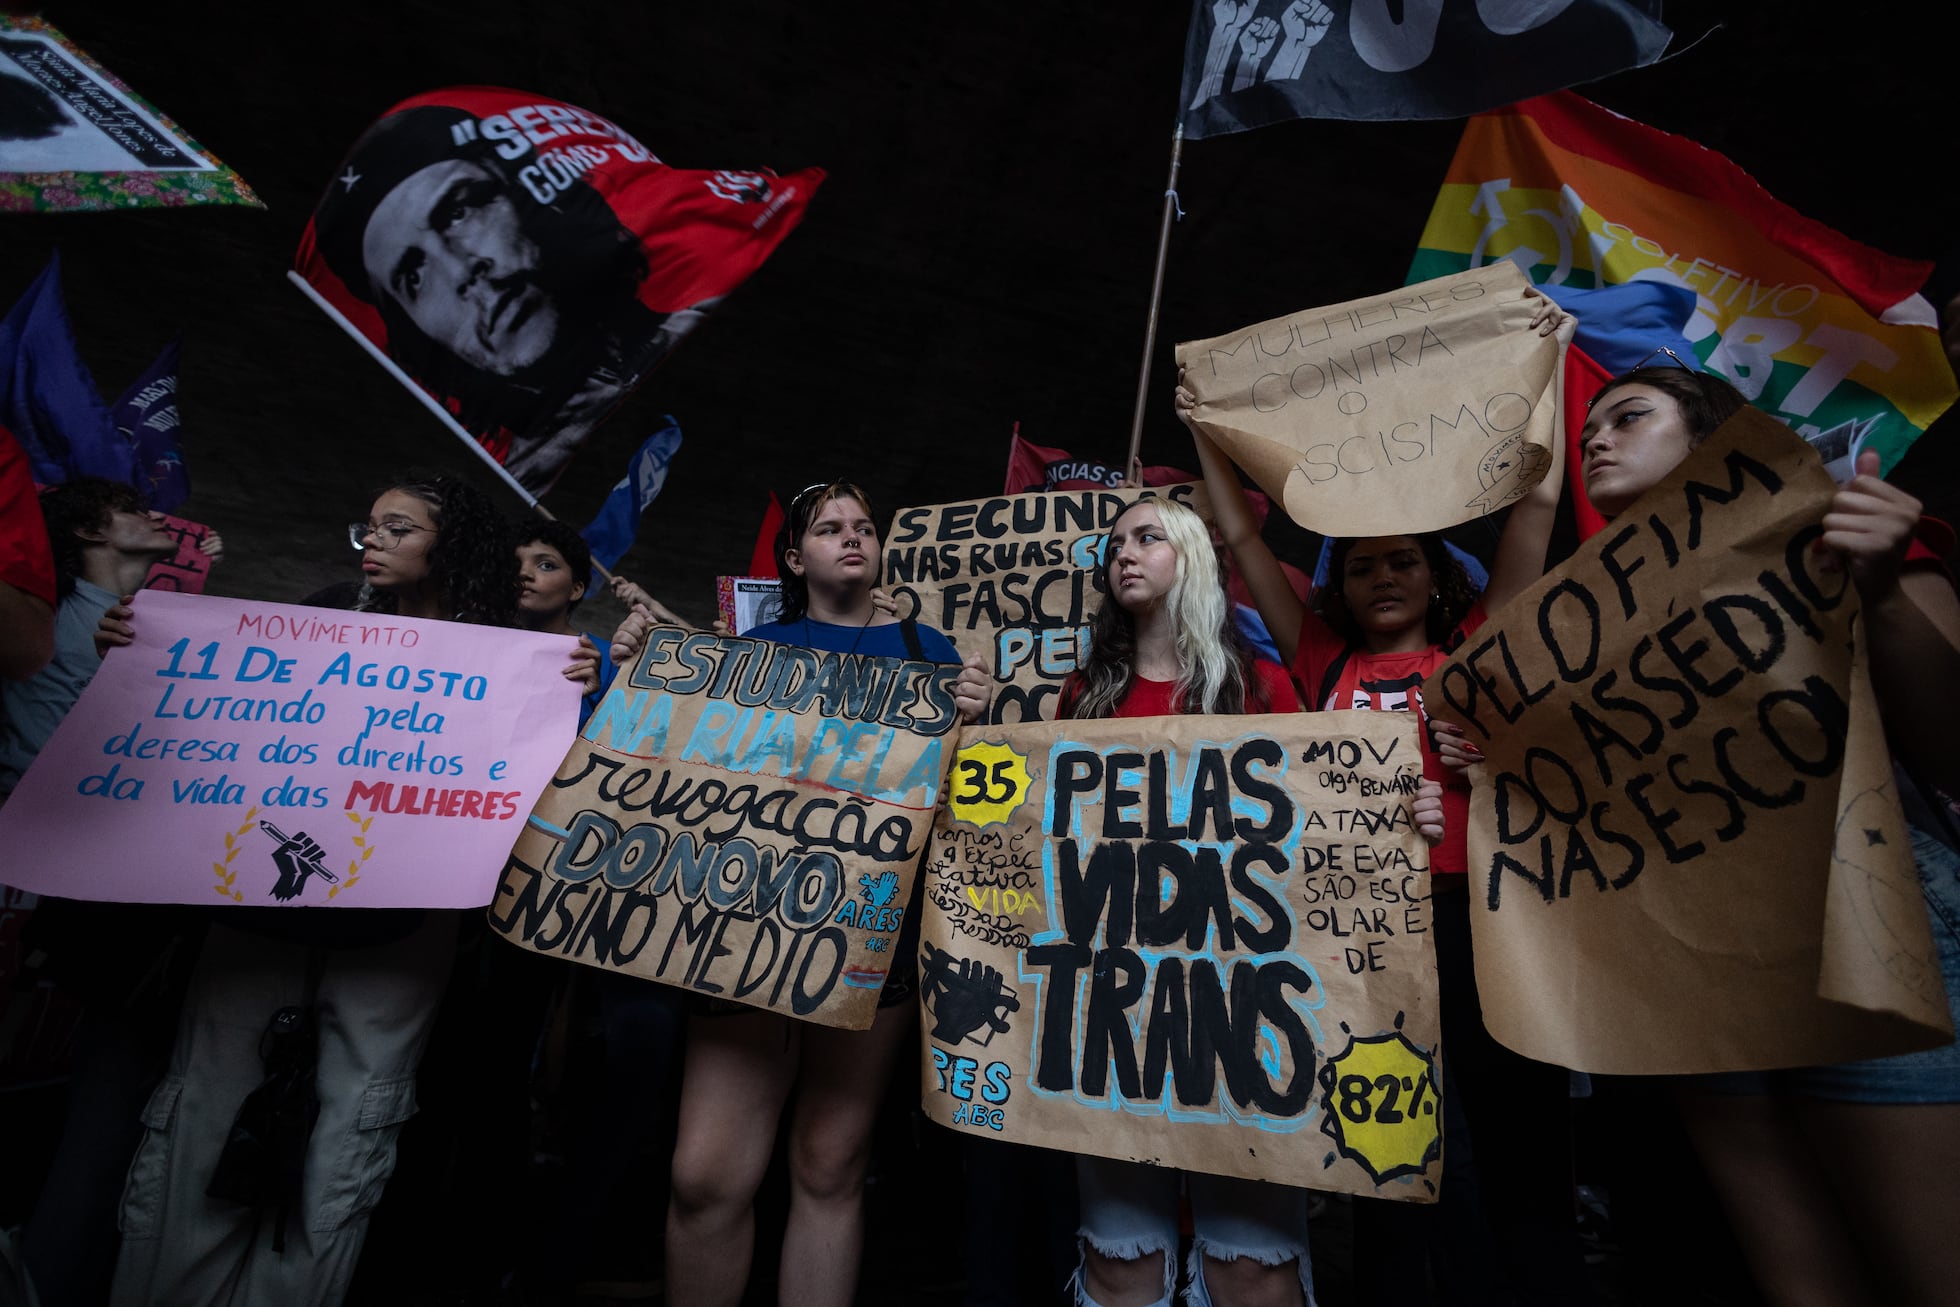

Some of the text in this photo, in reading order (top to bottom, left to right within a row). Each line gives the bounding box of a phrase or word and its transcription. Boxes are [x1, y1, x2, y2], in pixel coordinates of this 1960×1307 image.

[1209, 280, 1485, 377] MULHERES
[1251, 325, 1455, 413] CONTRA
[1337, 391, 1368, 415] O
[892, 484, 1195, 543] SECUNDS
[887, 544, 961, 584] NAS
[968, 538, 1064, 577] RUAS
[1441, 449, 1785, 741] PELO FIM
[236, 613, 420, 649] MOVIMENTO
[156, 637, 221, 682] 11
[317, 652, 488, 701] AGOSTO
[629, 625, 962, 738] ESTUDANTES
[362, 701, 445, 738] pela
[258, 735, 319, 765] dos
[338, 733, 464, 777] direitos
[488, 758, 507, 781] e
[584, 688, 943, 810] NA RUA PELA
[1302, 737, 1400, 768] MOV
[77, 764, 522, 821] da vida das MULHERES
[552, 752, 920, 862] revogação
[956, 760, 1019, 806] 35
[1051, 738, 1297, 844] PELAS
[1494, 747, 1588, 845] DO
[937, 825, 1032, 852] anos é
[1305, 803, 1416, 836] A TAXA
[553, 808, 846, 933] DO NOVO
[1302, 844, 1344, 873] DE
[1487, 800, 1645, 912] NAS
[487, 853, 659, 967] ENSINO
[967, 886, 1042, 915] VIDA
[1058, 838, 1292, 954] VIDAS
[1303, 873, 1357, 904] SÃO
[835, 899, 904, 933] ARES
[1306, 903, 1428, 937] OLAR É
[865, 936, 891, 953] ABC
[1345, 941, 1386, 974] DE
[1025, 944, 1316, 1117] TRANS
[953, 1102, 1005, 1132] ABC
[1338, 1072, 1434, 1125] 82%
